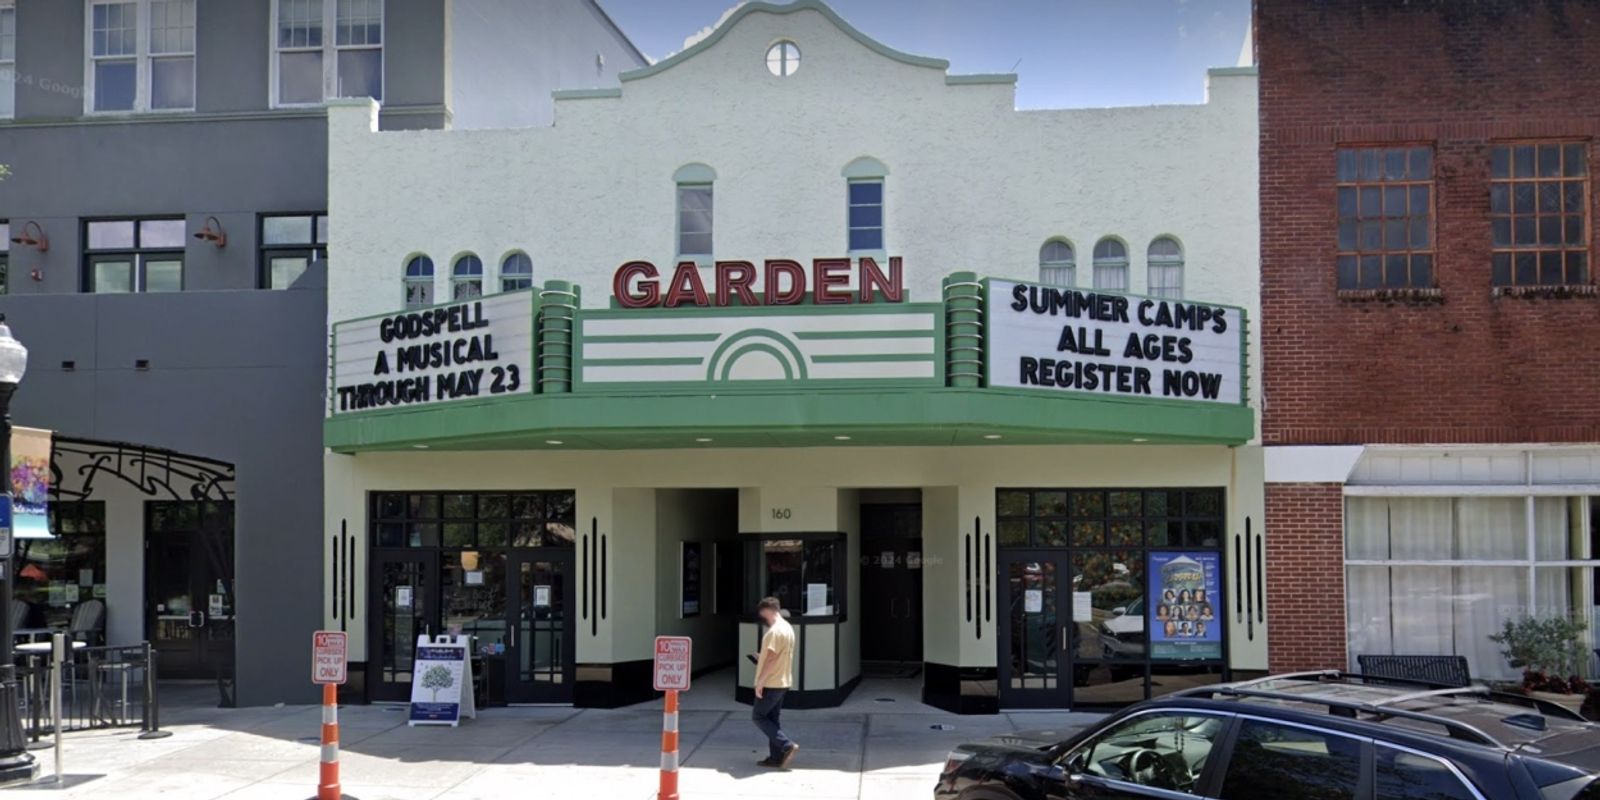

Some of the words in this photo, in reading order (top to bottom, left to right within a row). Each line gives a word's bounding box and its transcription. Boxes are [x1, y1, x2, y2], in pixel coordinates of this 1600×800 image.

[613, 256, 903, 308] GARDEN
[380, 302, 489, 343] GODSPELL
[1011, 284, 1129, 323] SUMMER
[1137, 299, 1227, 334] CAMPS
[374, 351, 389, 375] A
[397, 334, 498, 373] MUSICAL
[1057, 325, 1111, 356] ALL
[1123, 332, 1193, 364] AGES
[337, 375, 430, 411] THROUGH
[437, 368, 484, 400] MAY
[490, 364, 520, 393] 23
[1020, 356, 1152, 394] REGISTER
[1162, 369, 1222, 399] NOW
[772, 508, 791, 520] 160
[318, 635, 328, 646] 10
[659, 640, 670, 652] 10
[320, 667, 338, 677] ONLY
[662, 674, 681, 684] ONLY
[677, 663, 686, 671] UP
